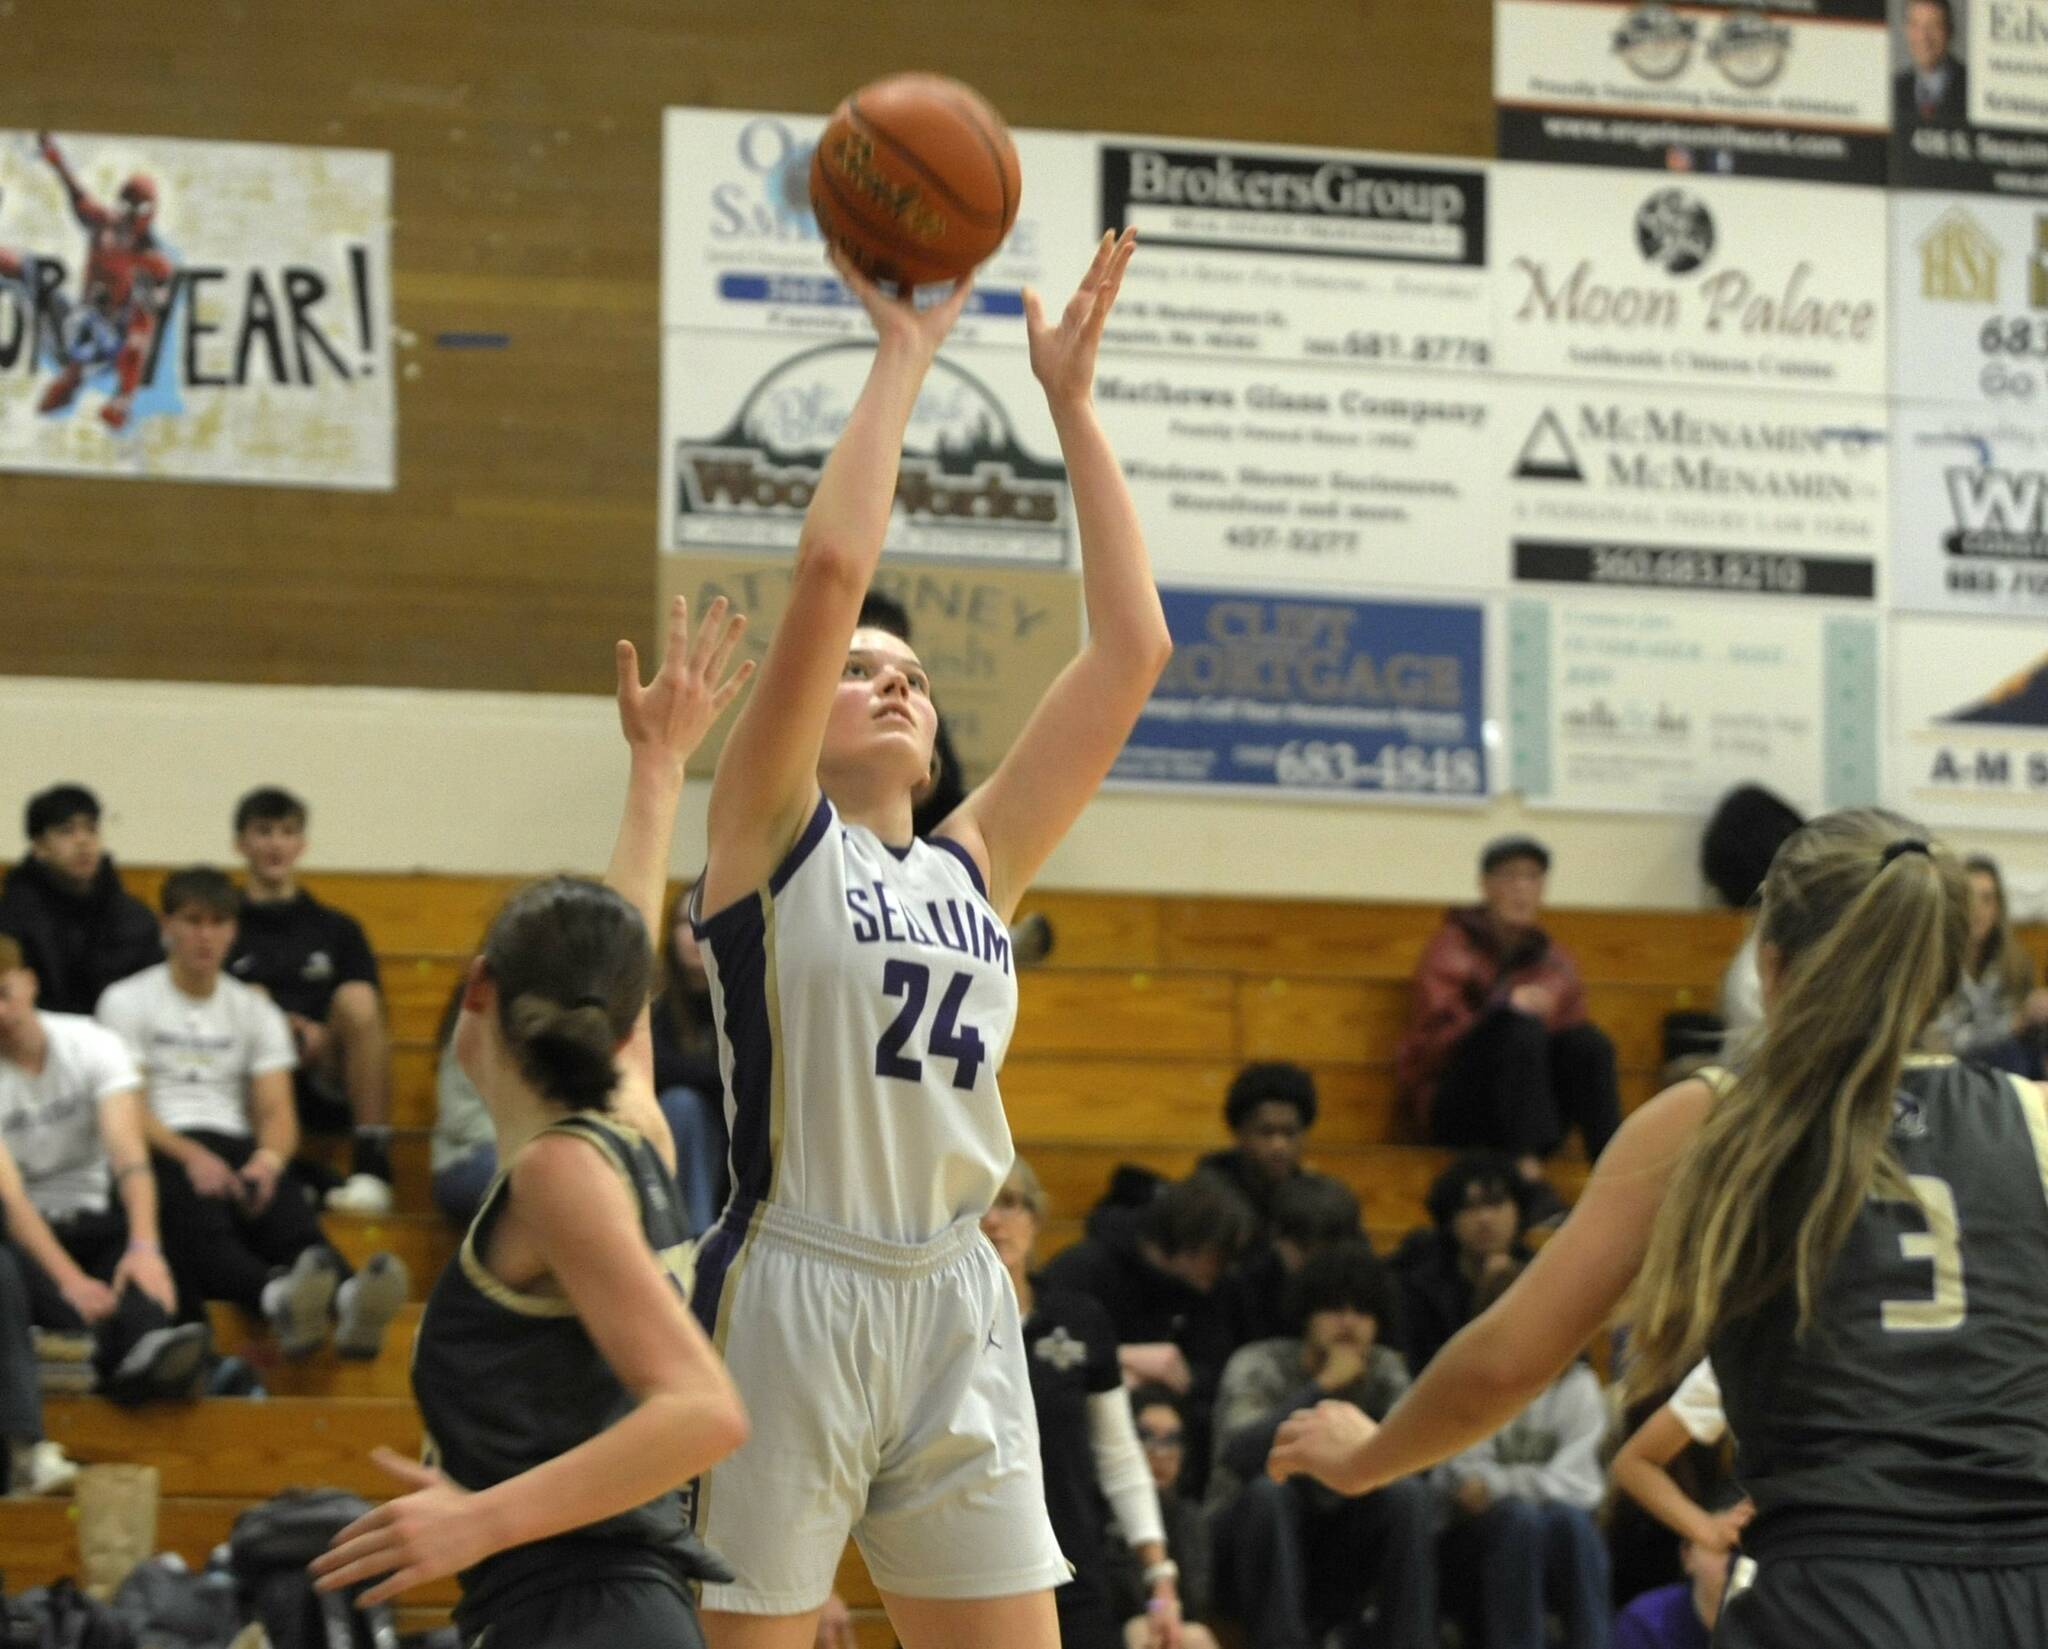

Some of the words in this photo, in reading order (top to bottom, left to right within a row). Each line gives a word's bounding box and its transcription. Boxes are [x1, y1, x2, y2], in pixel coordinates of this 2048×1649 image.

[1129, 150, 1466, 228] BrokersGroup
[1513, 254, 1682, 334] Moon
[1699, 258, 1876, 344] Palace
[1338, 388, 1488, 428] Company
[875, 958, 985, 1091] 24
[1868, 1173, 1968, 1333] 3
